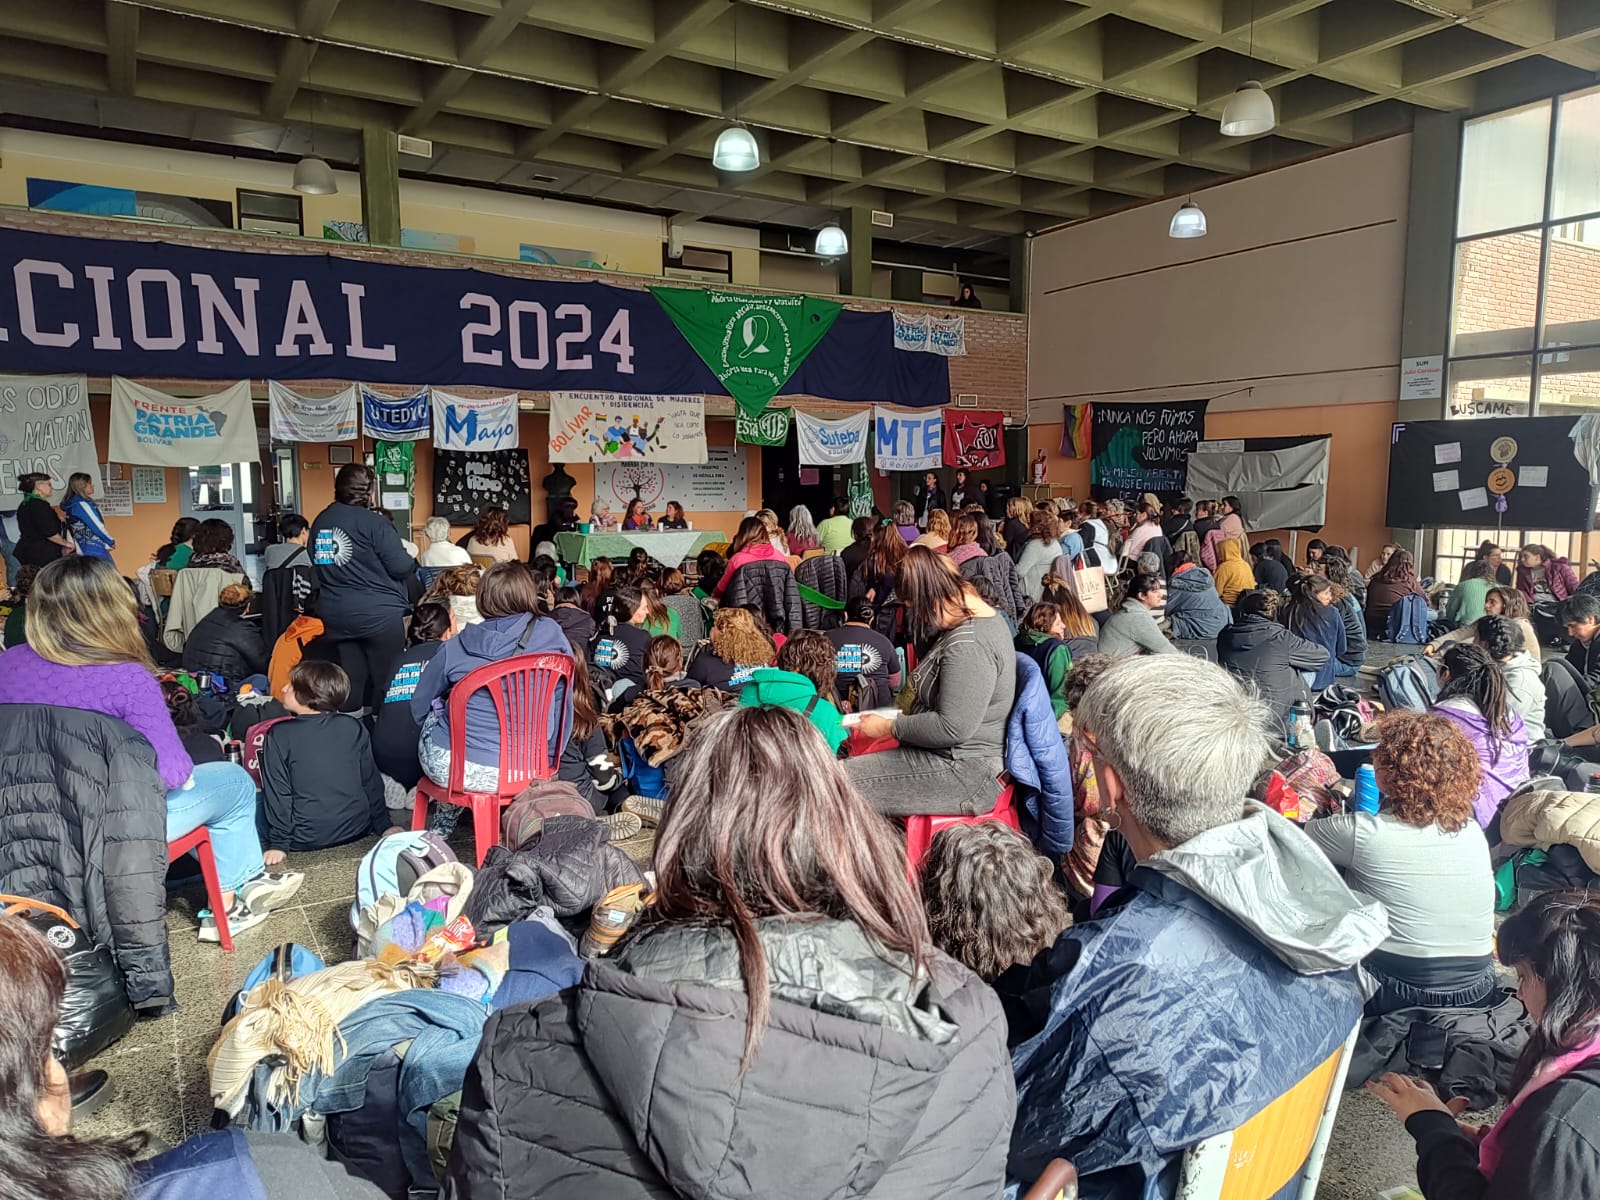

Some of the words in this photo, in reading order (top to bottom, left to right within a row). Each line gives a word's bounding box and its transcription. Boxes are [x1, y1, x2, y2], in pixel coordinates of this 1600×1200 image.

[0, 259, 397, 361] CIONAL
[460, 292, 634, 374] 2024
[0, 387, 17, 412] S
[26, 383, 80, 410] ODIO
[569, 392, 615, 401] ENCUENTRO
[618, 394, 652, 402] REGIONAL
[609, 401, 655, 409] DISIDENCIAS
[134, 400, 186, 414] FRENTE
[371, 404, 427, 424] UTEDYC
[1450, 402, 1515, 416] BUSCAME
[136, 408, 210, 427] PATRIA
[445, 404, 514, 449] Mayo
[1136, 409, 1156, 425] NOS
[24, 409, 92, 452] MATAN
[133, 421, 217, 439] GRANDE
[550, 405, 593, 453] BOLÍVAR
[818, 427, 861, 446] Suteba
[877, 417, 942, 456] MTE
[1142, 427, 1165, 446] PERO
[1168, 428, 1199, 445] AHORA
